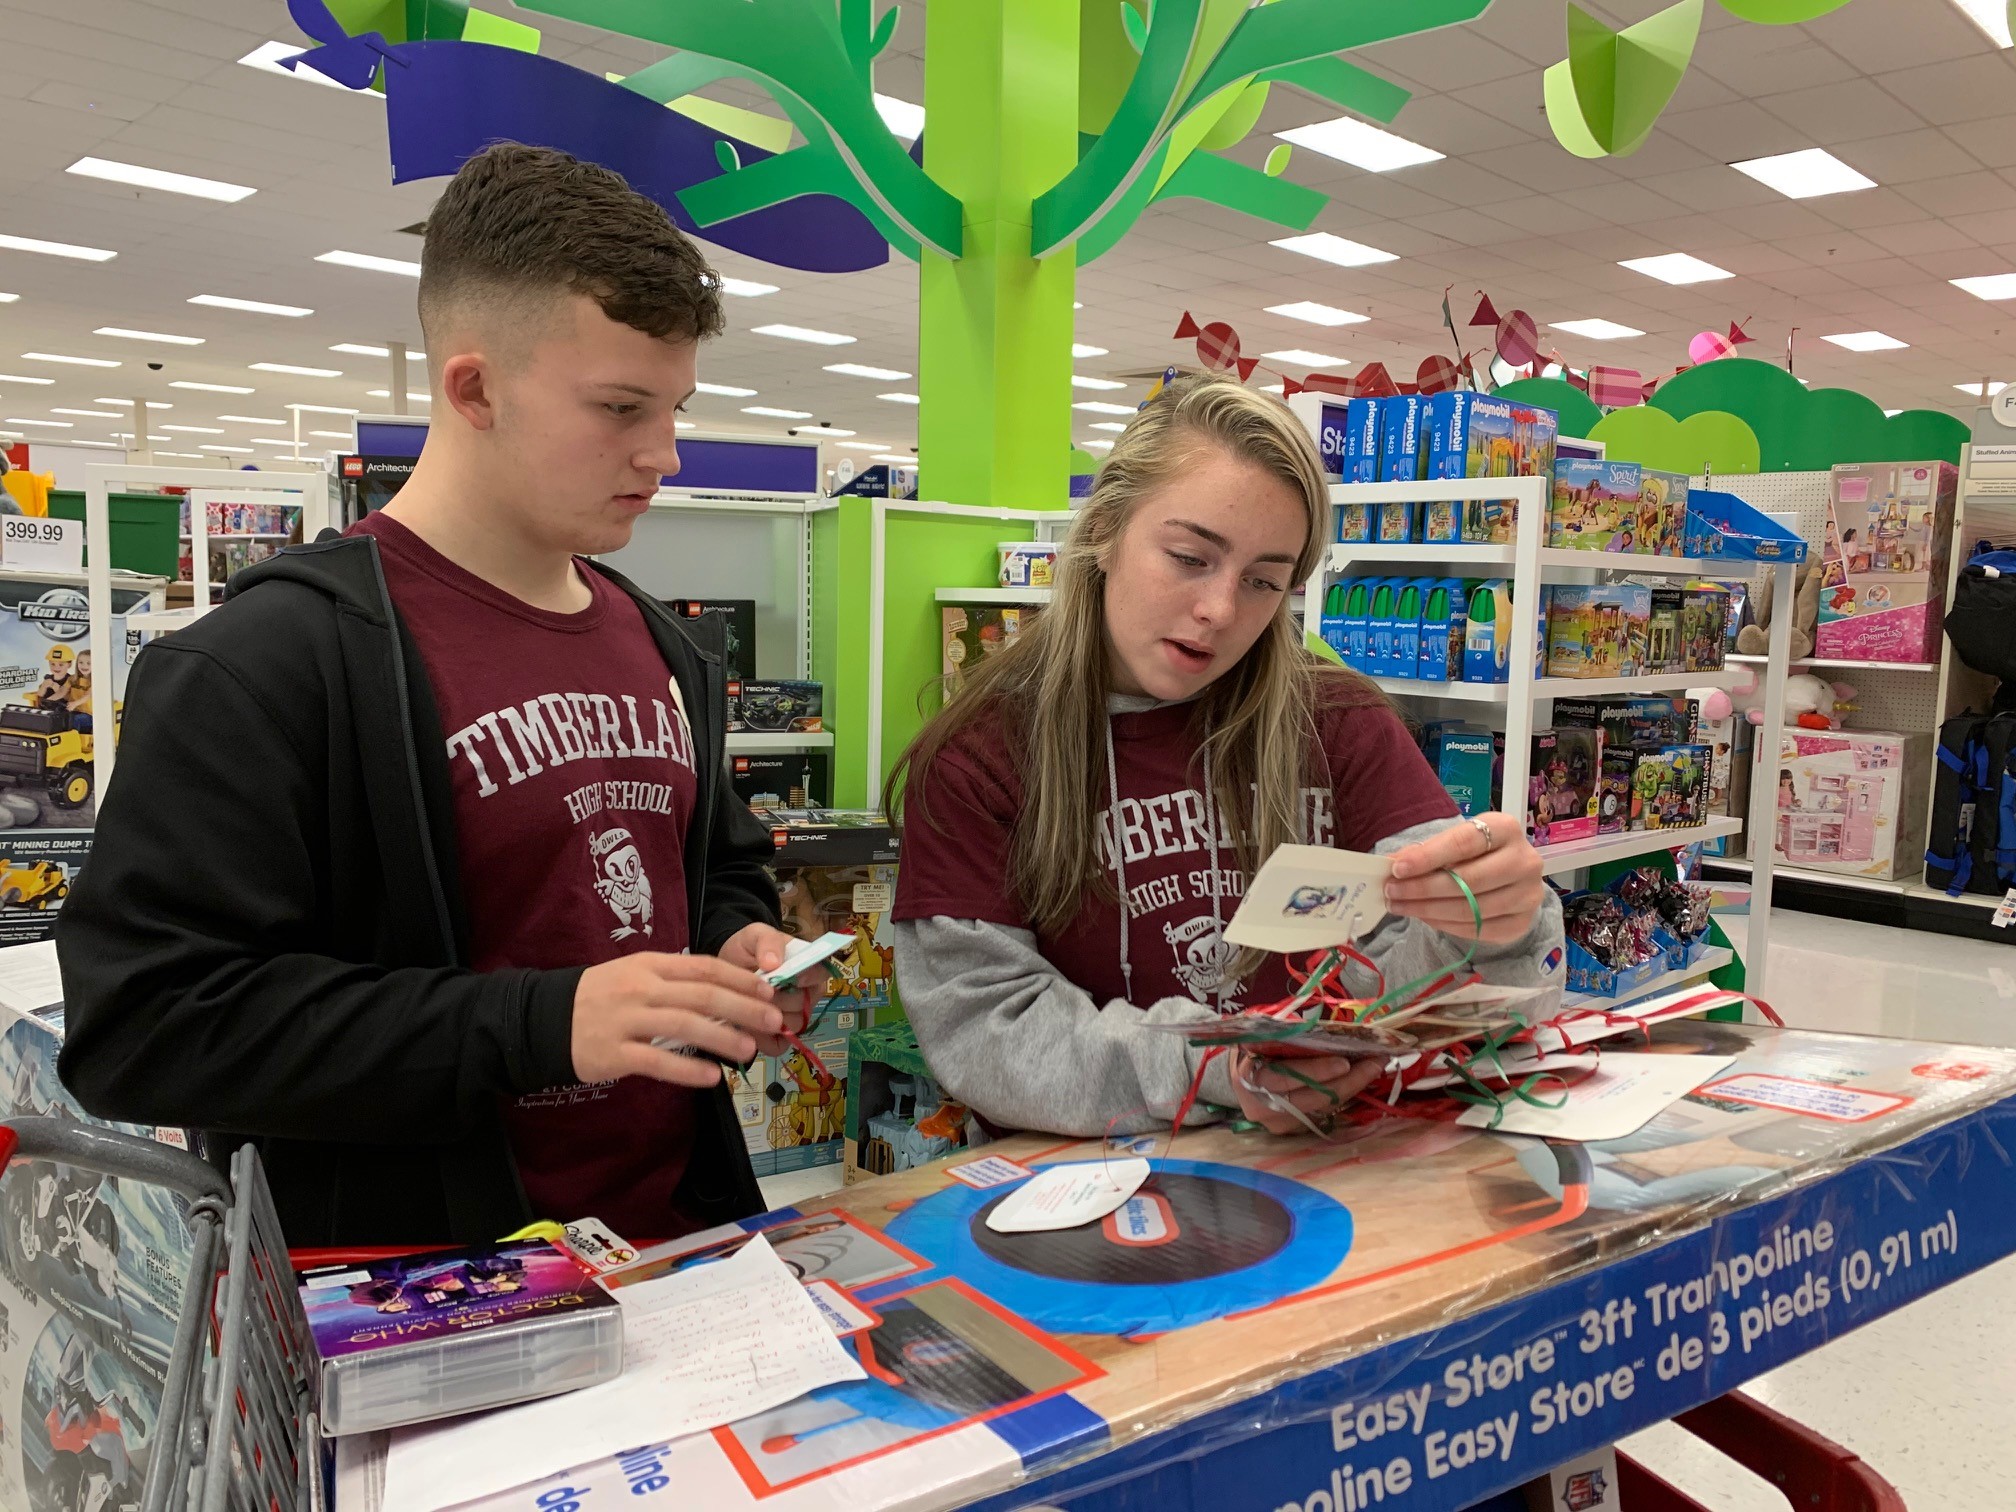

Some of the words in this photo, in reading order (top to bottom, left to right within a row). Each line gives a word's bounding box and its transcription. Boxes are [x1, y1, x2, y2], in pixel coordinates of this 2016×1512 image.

[1471, 398, 1510, 419] playmobil
[1366, 400, 1377, 456] playmobil
[1406, 398, 1418, 455] playmobil
[1453, 394, 1465, 452] playmobil
[1387, 435, 1395, 455] 9423
[367, 462, 415, 474] Architectur
[1572, 462, 1603, 471] playmobil
[1610, 464, 1639, 486] Spirit
[5, 522, 63, 541] 399.99
[0, 675, 37, 686] OULDERS
[1555, 703, 1596, 715] playmobil
[1601, 705, 1643, 721] playmobil
[446, 693, 697, 798] TIMBERLAN
[1446, 742, 1489, 751] playmobil
[1603, 748, 1634, 758] playmobil
[750, 760, 783, 769] Architecture
[1638, 752, 1673, 765] playmobil
[563, 782, 602, 824] HIGH
[605, 781, 673, 815] SCHOOL
[12, 841, 50, 849] MINING
[52, 840, 82, 849] DUMP
[601, 831, 625, 850] OWLS
[1126, 875, 1184, 919] HIGH
[1188, 870, 1250, 899] SCHO
[1184, 919, 1212, 937] OWLS
[158, 1129, 164, 1141] 6
[164, 1130, 183, 1143] Volts
[146, 1247, 170, 1270] BONUS
[146, 1259, 182, 1290] FEATURES
[448, 1294, 585, 1325] DOCTOR
[350, 1321, 441, 1343] WHO
[127, 1347, 157, 1378] Maximum
[1273, 1457, 1412, 1512] oline
[1424, 1410, 1519, 1480] Easy
[1530, 1365, 1635, 1435] Store
[1656, 1332, 1704, 1381] de
[1710, 1311, 1731, 1356] 3
[1740, 1270, 1831, 1354] pieds
[1840, 1230, 1912, 1304] (0,91
[1921, 1209, 1958, 1260] m)
[1331, 1382, 1431, 1452] Easy
[1444, 1337, 1556, 1408] Store
[1579, 1297, 1637, 1353] 3ft
[536, 1486, 592, 1512] de
